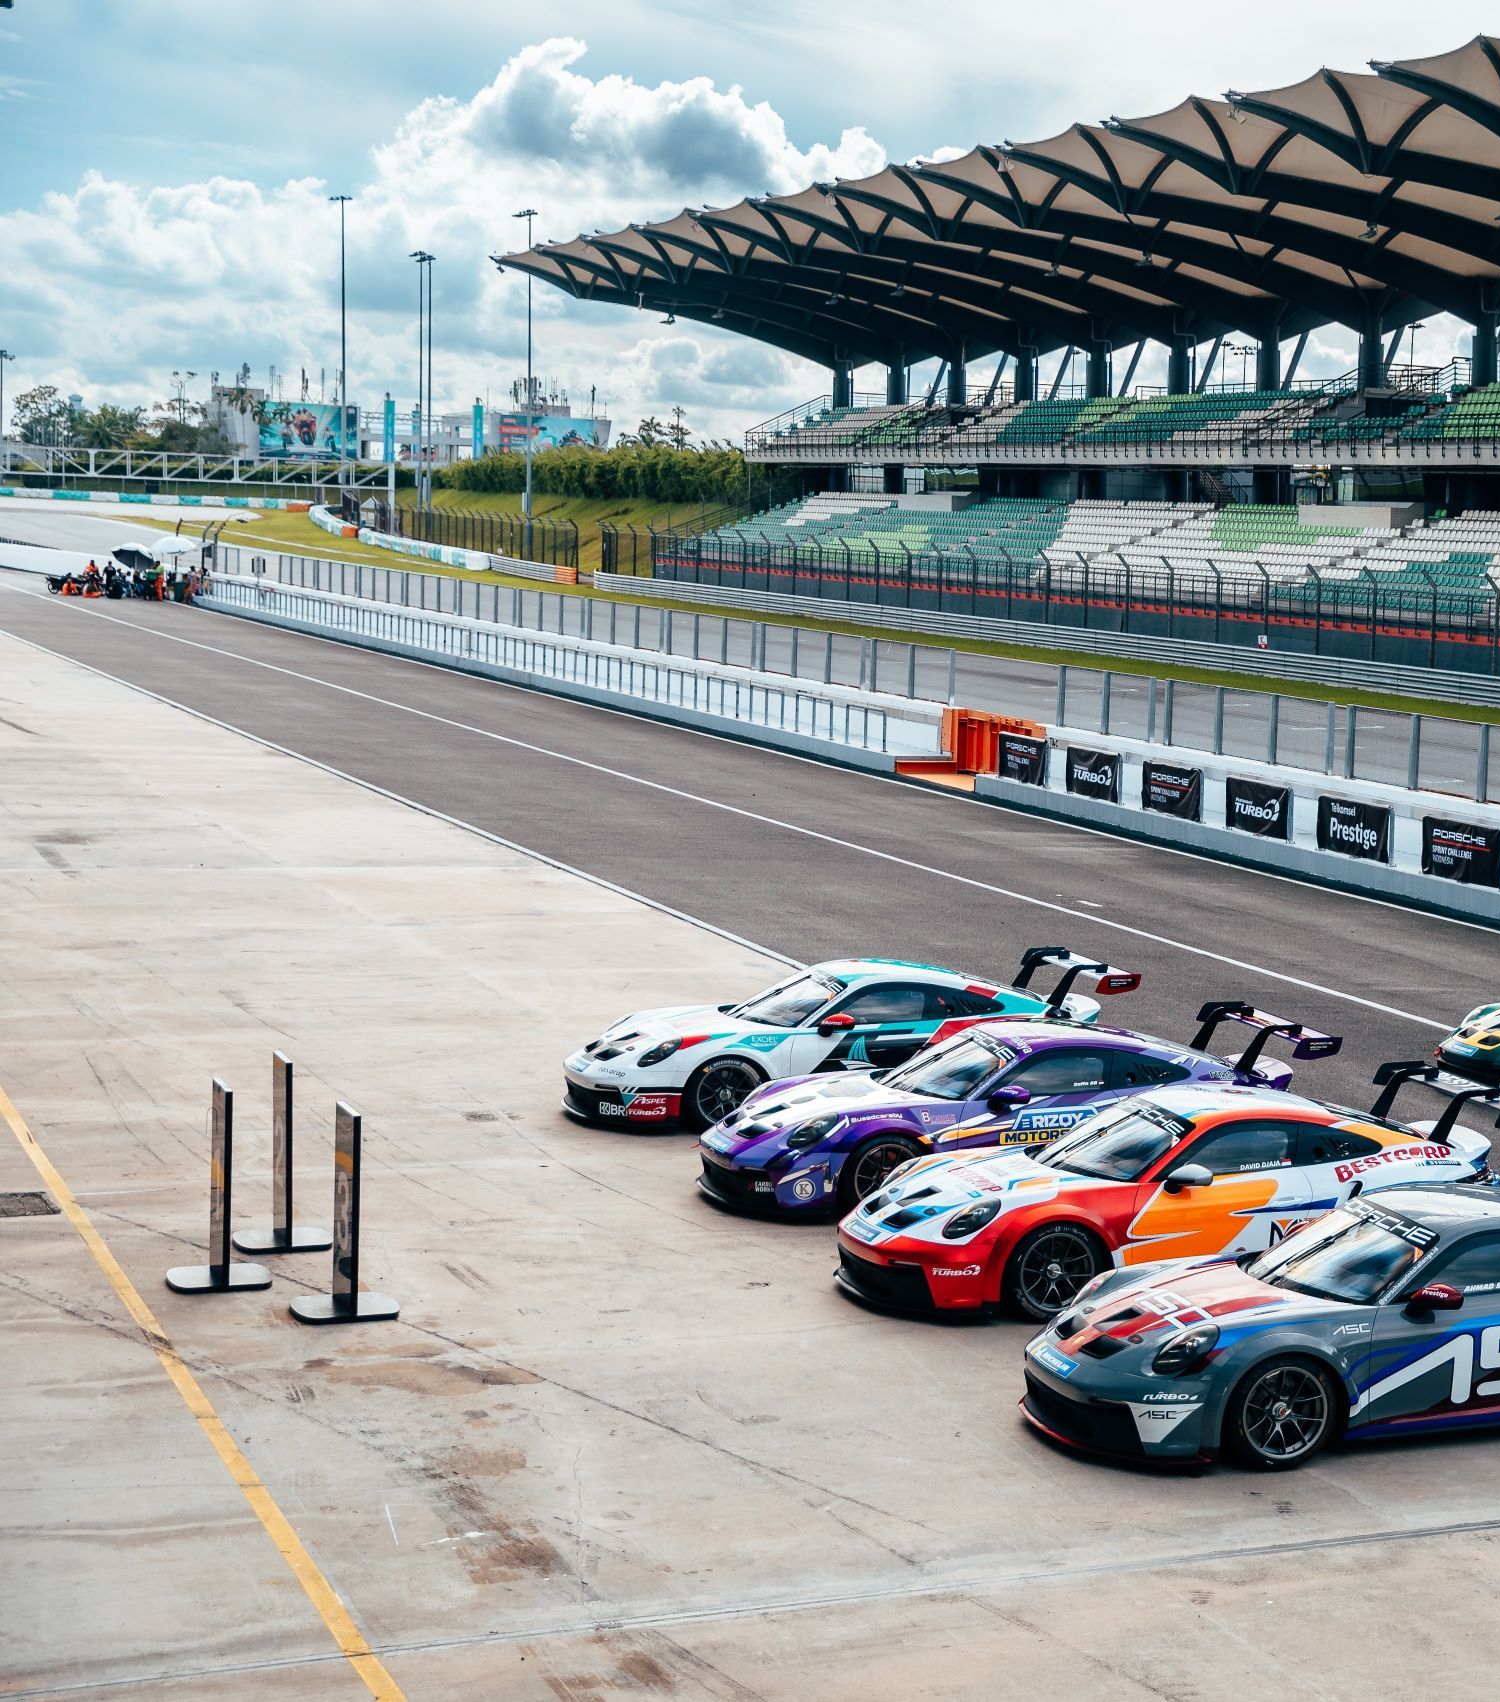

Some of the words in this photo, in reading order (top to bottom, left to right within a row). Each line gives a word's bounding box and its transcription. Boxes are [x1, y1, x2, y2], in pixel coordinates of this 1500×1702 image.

[1006, 741, 1037, 755] PORSCHE
[1073, 768, 1106, 784] TURBO
[1151, 772, 1189, 787] PORSCHE
[1235, 801, 1272, 820] TURBO
[1331, 802, 1356, 817] Telkomsel
[1330, 817, 1377, 850] Prestige
[1433, 828, 1486, 846] PORSCHE
[1432, 844, 1447, 855] SPRINT
[1448, 847, 1472, 860] CHALLENGE
[628, 1108, 660, 1116] TURBO
[1240, 1162, 1261, 1171] DAVID
[1333, 1146, 1451, 1183] BESTCORP
[799, 1183, 810, 1195] K
[932, 1268, 972, 1276] TURBO
[1422, 1289, 1449, 1298] Prestige
[1463, 1282, 1494, 1292] AHMAD
[1332, 1322, 1371, 1336] ASC
[1138, 1410, 1177, 1420] ASC
